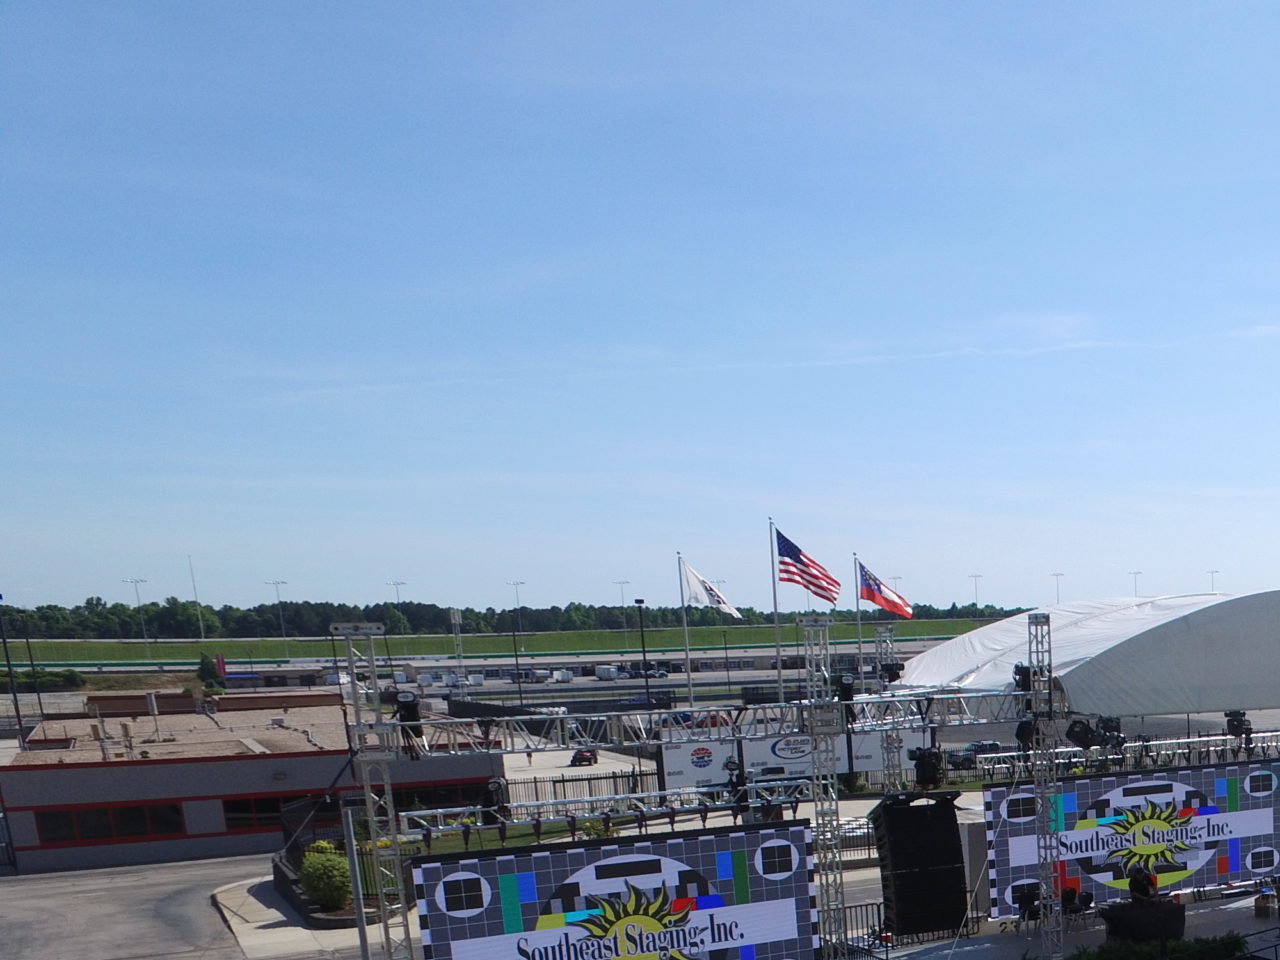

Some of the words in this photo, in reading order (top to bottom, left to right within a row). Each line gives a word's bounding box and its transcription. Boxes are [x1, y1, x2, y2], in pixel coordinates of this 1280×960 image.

[1059, 831, 1137, 856] Southeast
[1206, 818, 1233, 838] Inc.
[708, 913, 745, 944] Inc.
